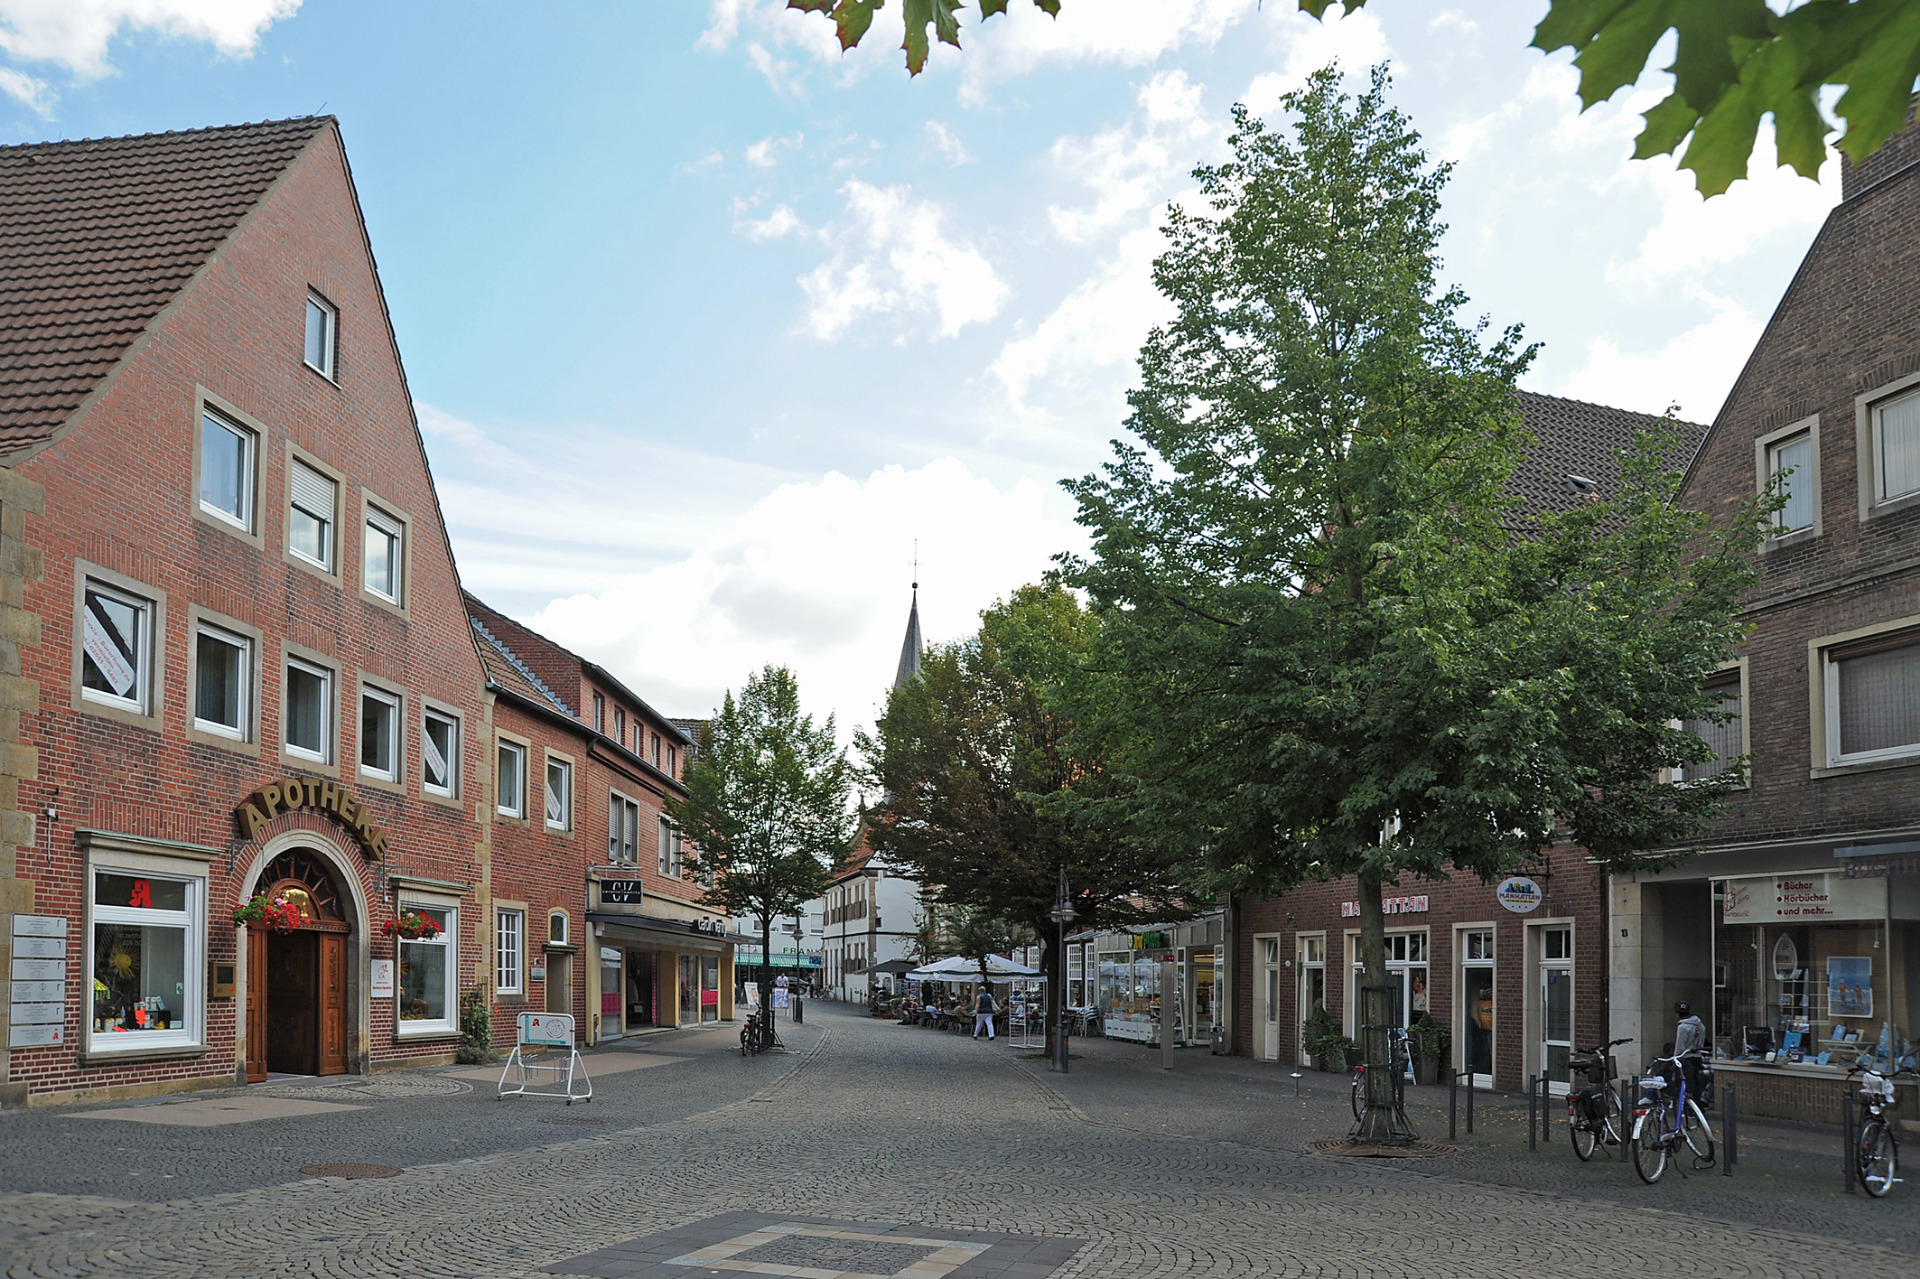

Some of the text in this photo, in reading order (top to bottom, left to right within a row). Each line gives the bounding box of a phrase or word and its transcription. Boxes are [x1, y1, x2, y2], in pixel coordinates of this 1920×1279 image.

[246, 778, 390, 860] APOTHEKE
[1783, 881, 1813, 890] Bücher
[1498, 892, 1540, 901] MANHATTAN
[1783, 893, 1828, 903] Hörbücher
[1341, 895, 1429, 918] MAATTAN
[1783, 905, 1833, 915] und mehr...
